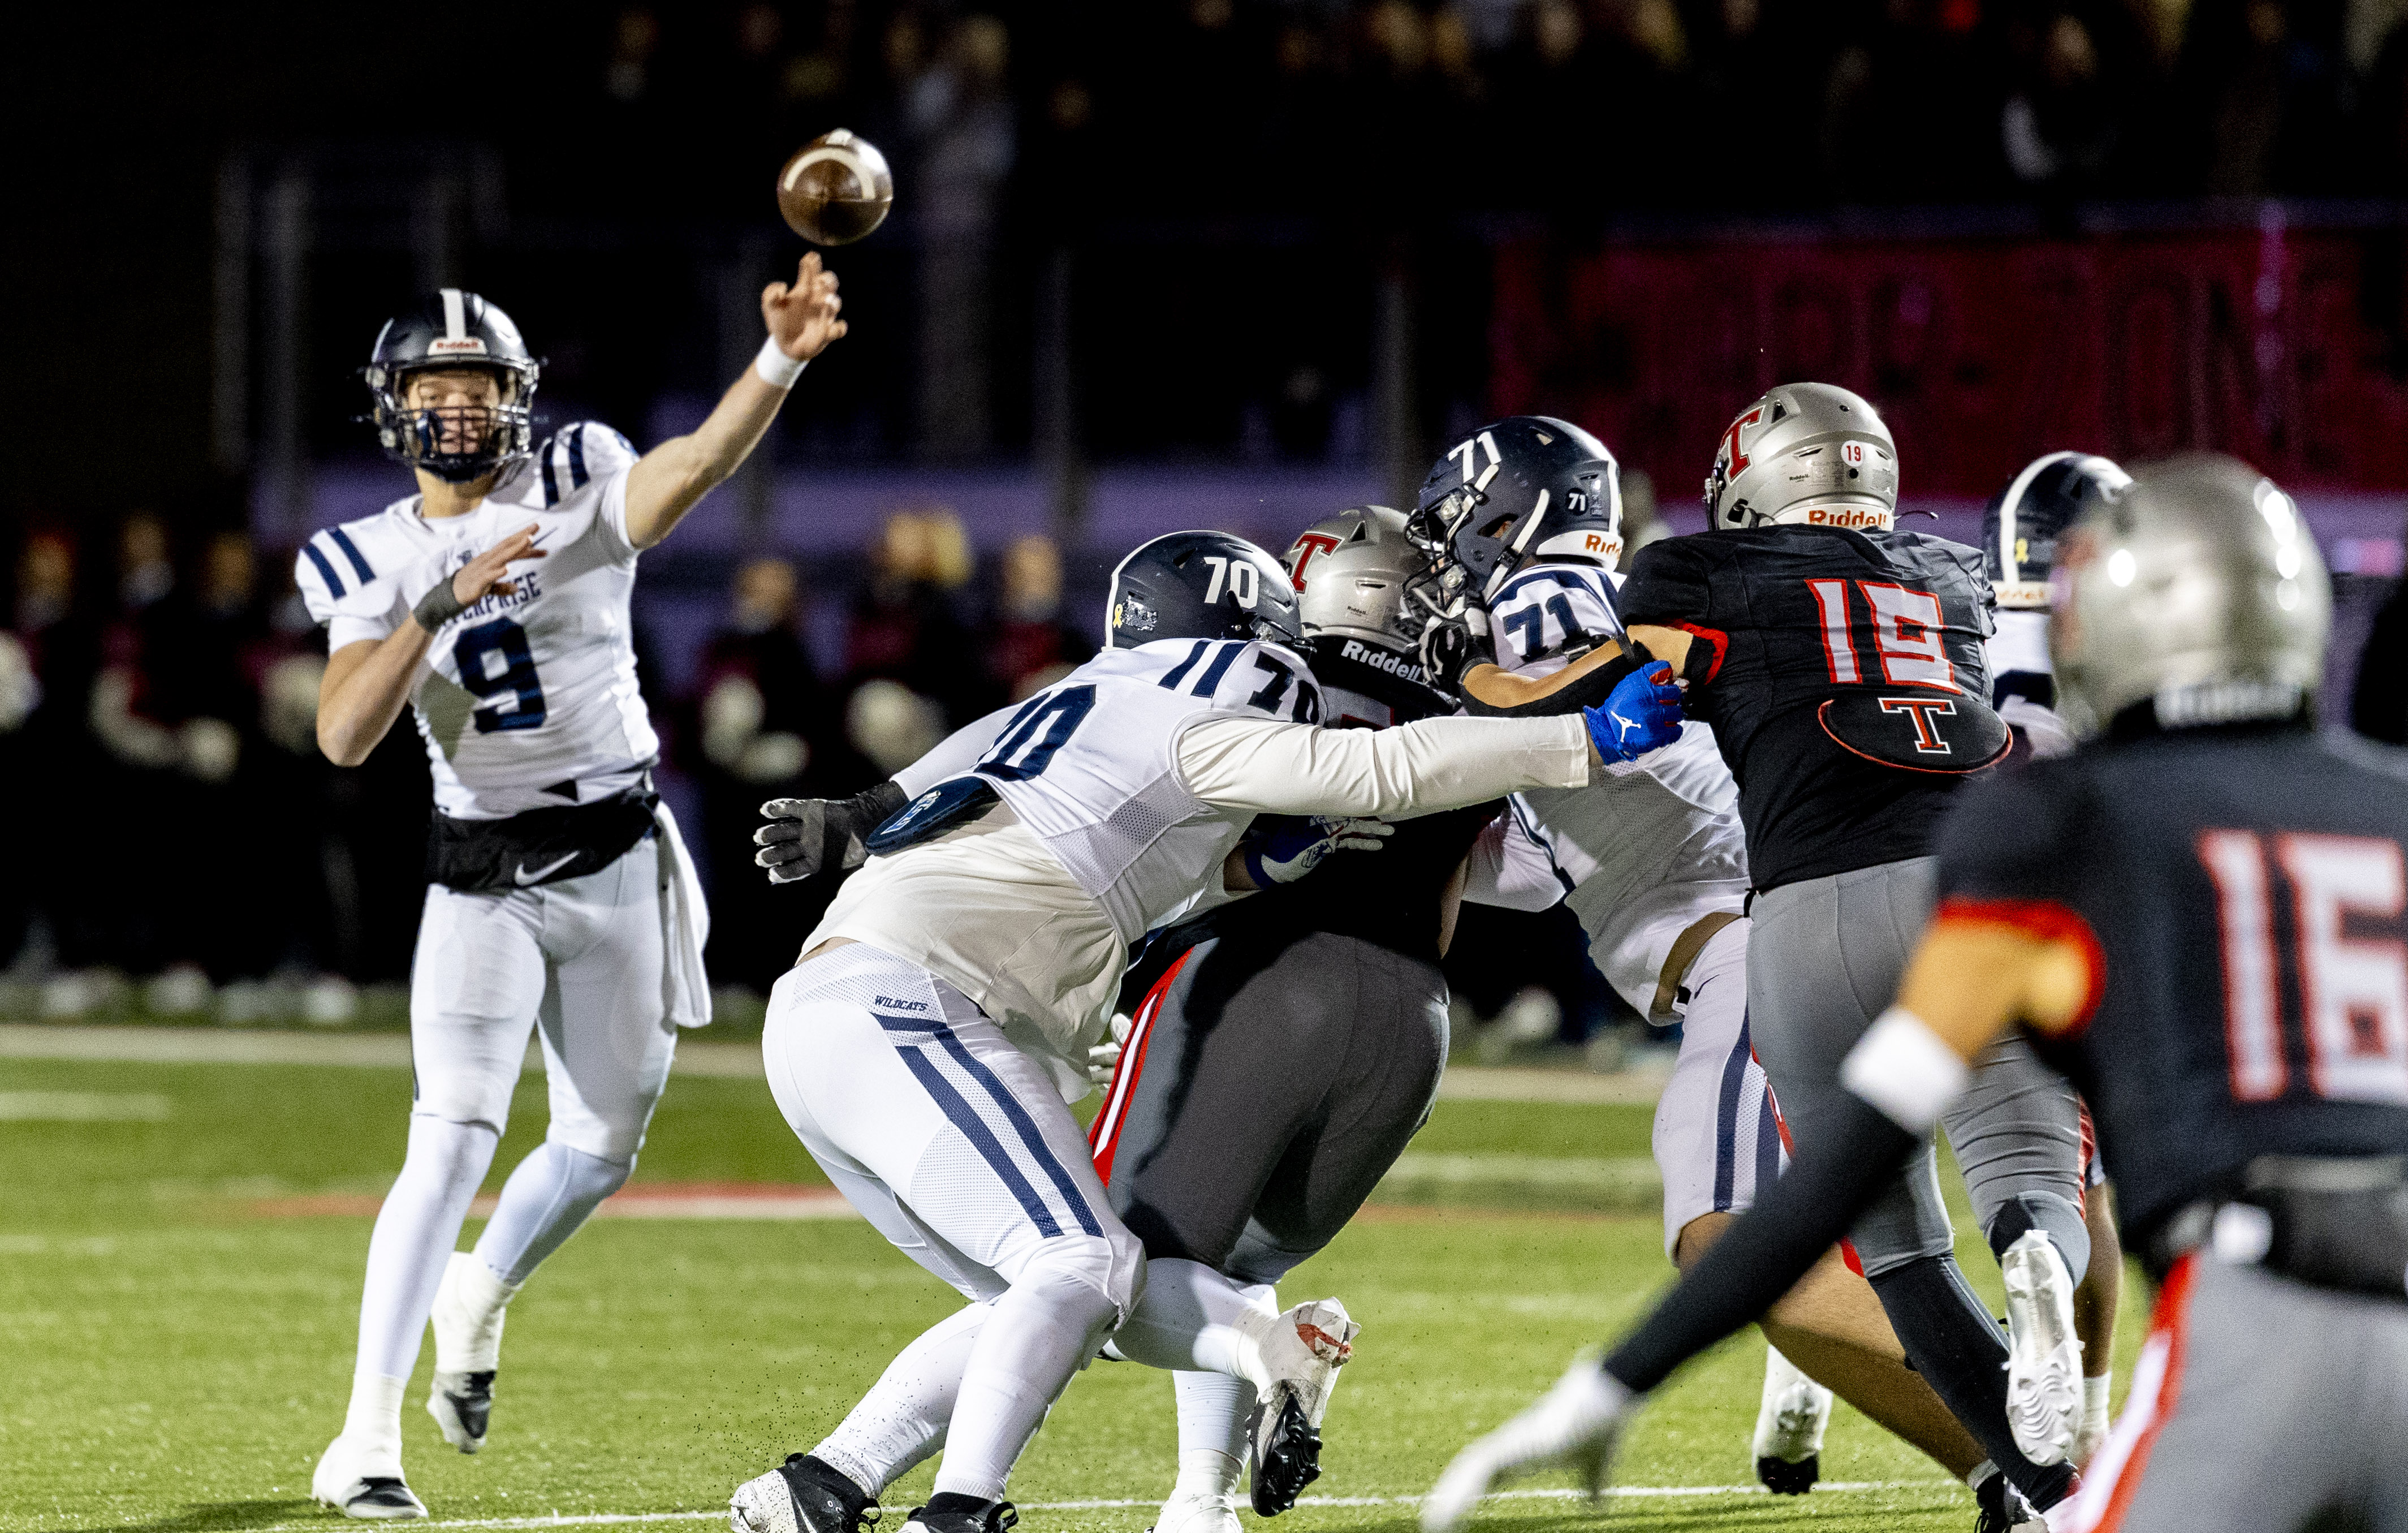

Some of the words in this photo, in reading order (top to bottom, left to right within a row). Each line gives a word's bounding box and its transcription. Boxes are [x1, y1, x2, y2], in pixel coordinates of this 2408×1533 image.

[1448, 432, 1501, 483] 71
[1720, 405, 1766, 485] T
[1846, 445, 1861, 462] 19
[1568, 493, 1586, 511] 71
[1204, 557, 1259, 609] 70
[1291, 532, 1344, 595] T
[1503, 592, 1587, 657] 71
[454, 616, 547, 734] 9
[1246, 650, 1320, 725] 70
[1341, 640, 1422, 681] Riddell
[1878, 697, 1957, 755] T
[2194, 828, 2408, 1106] 16
[875, 996, 929, 1011] WILDCATS
